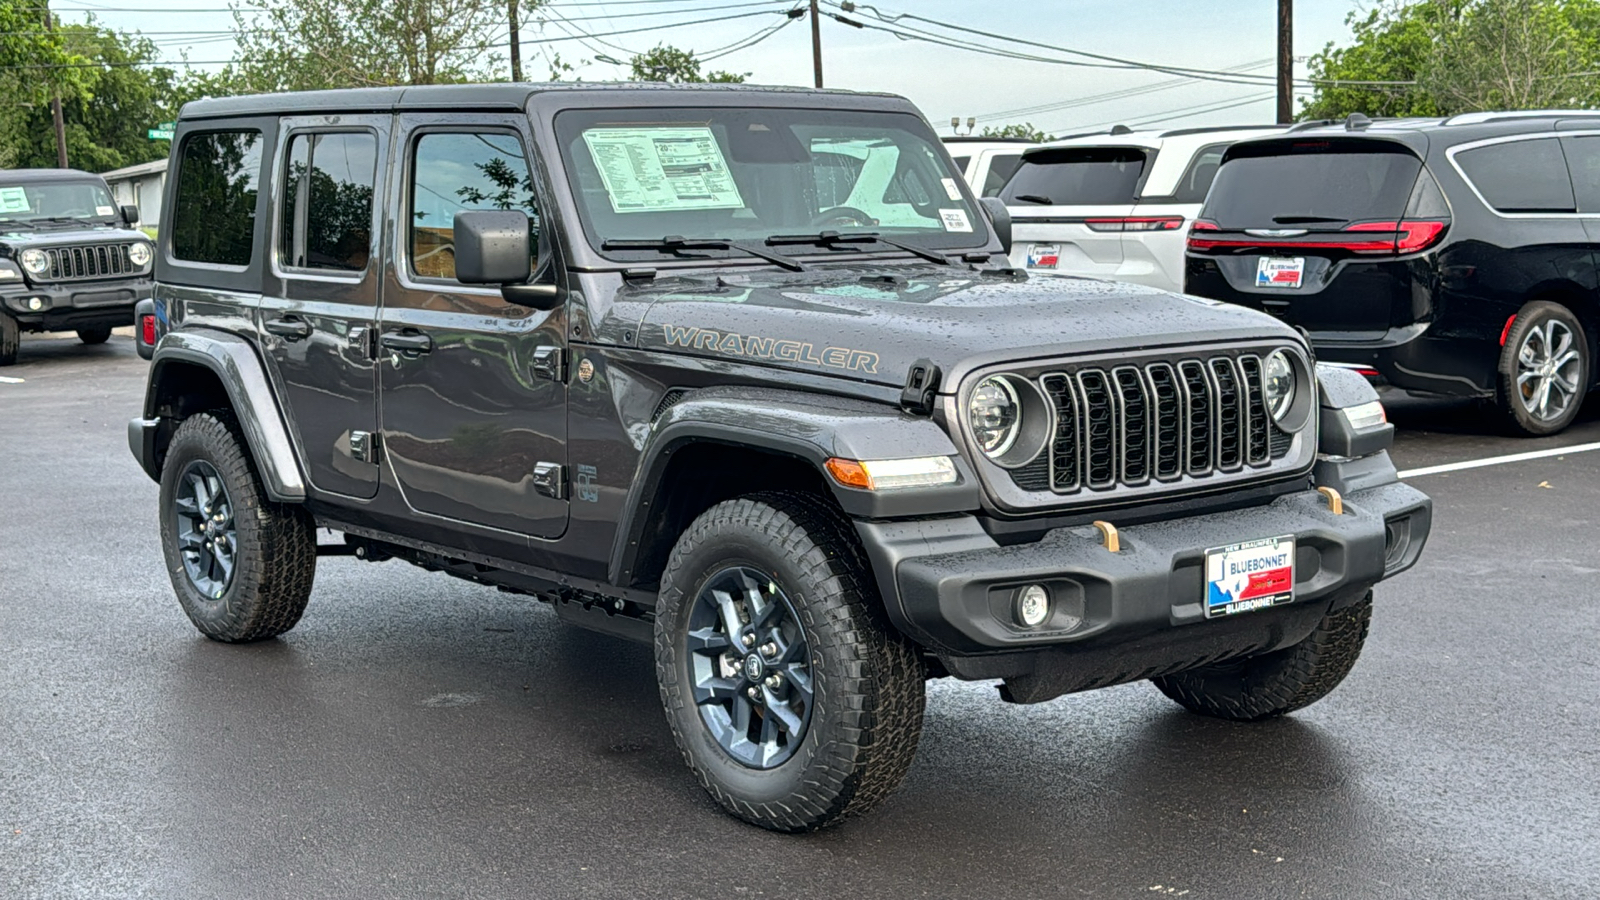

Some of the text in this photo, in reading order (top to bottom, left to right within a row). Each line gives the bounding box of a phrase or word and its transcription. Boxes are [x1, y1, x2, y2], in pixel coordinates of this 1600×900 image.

[663, 323, 880, 375] WRANGLER
[1225, 538, 1278, 553] NEW BRAUNFEL
[1230, 553, 1287, 575] BLUEBONNET
[1225, 596, 1275, 614] BLUEBONNET
